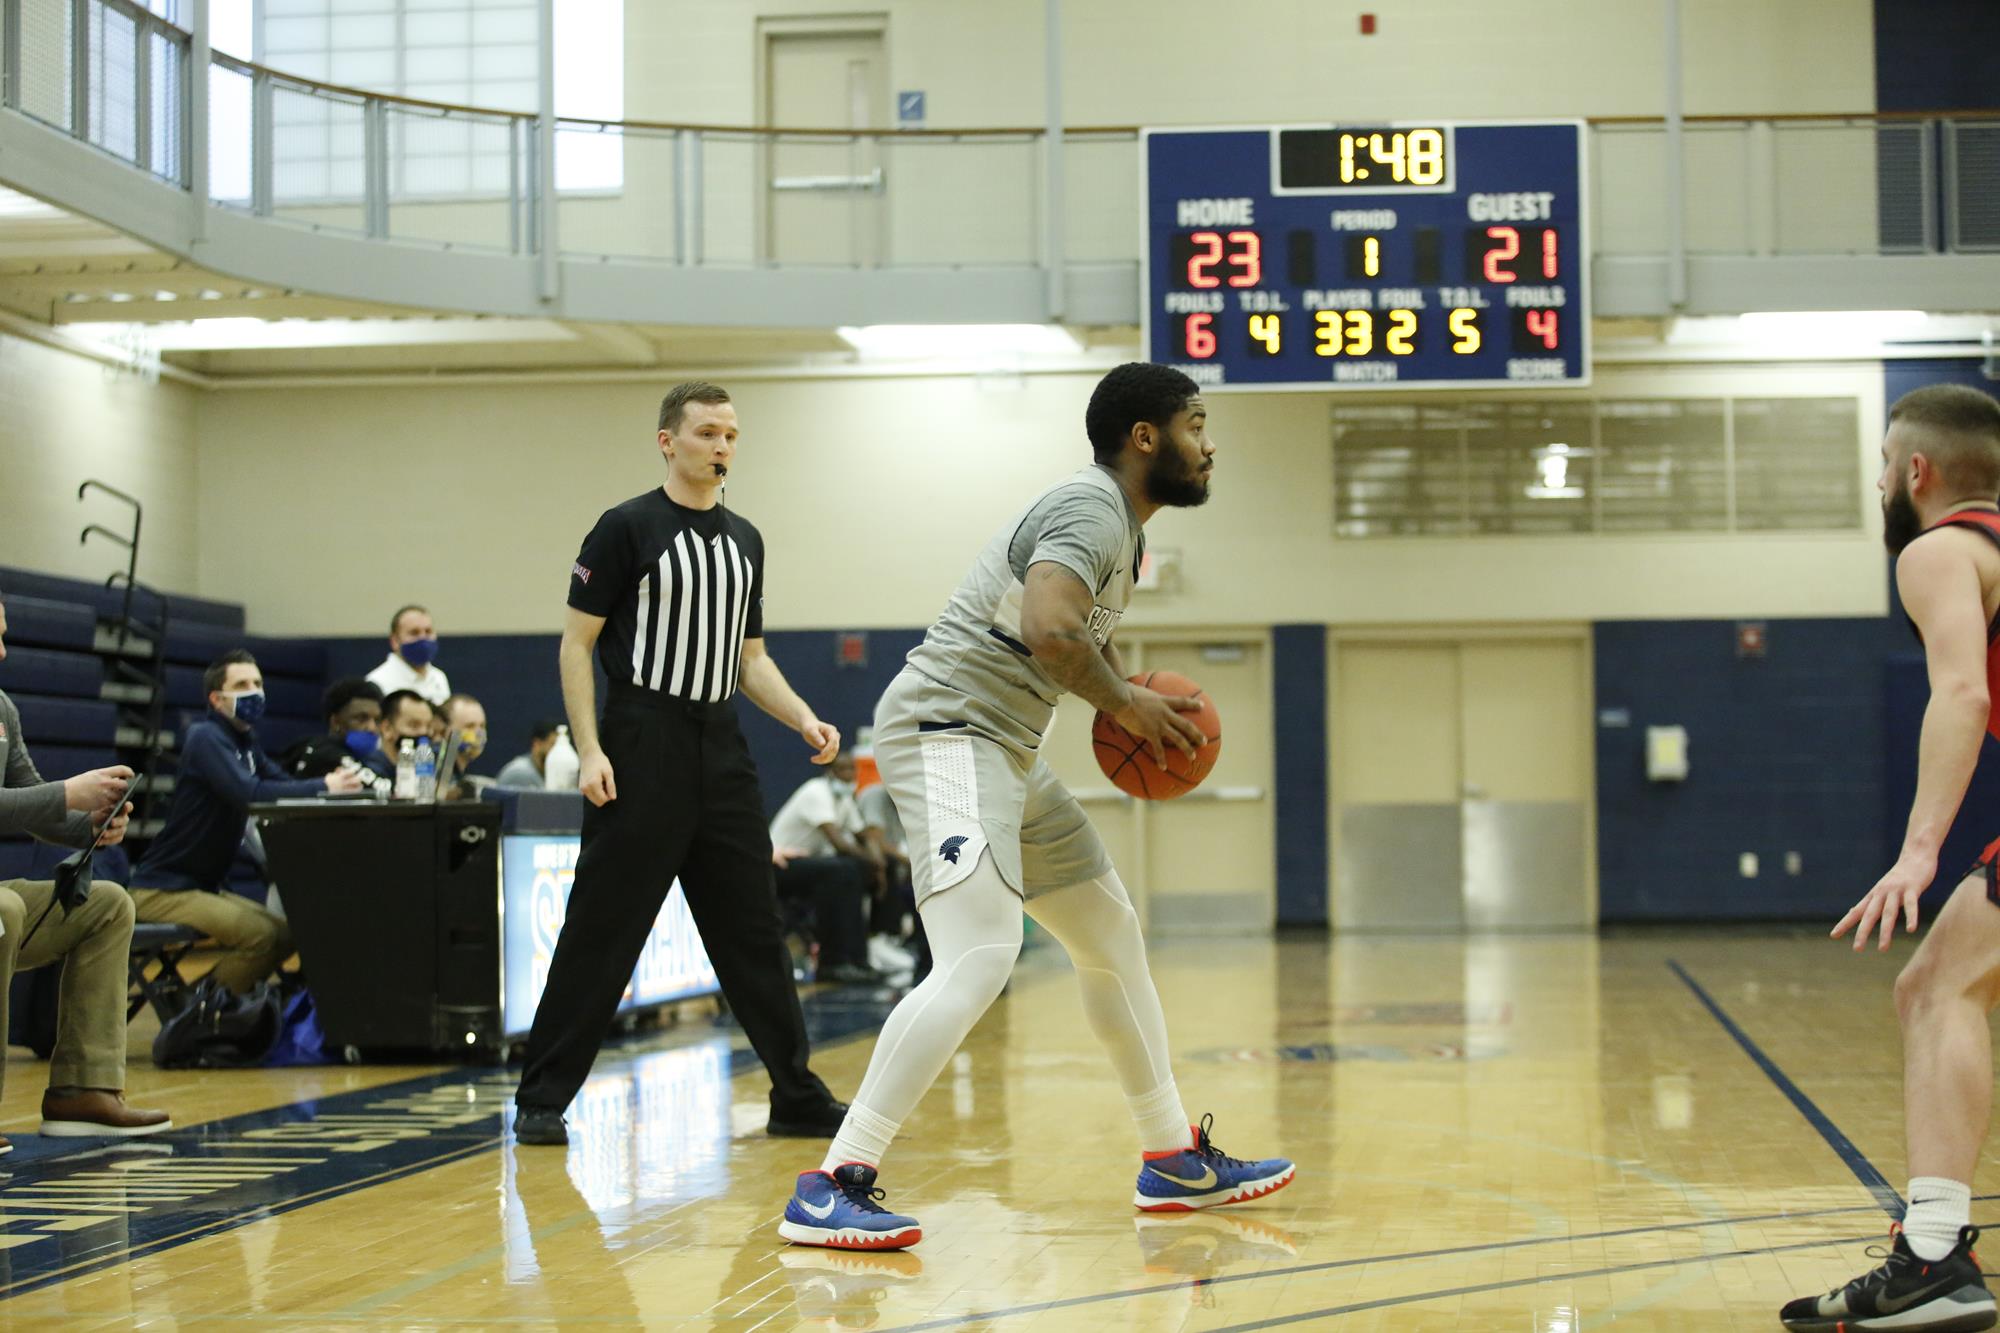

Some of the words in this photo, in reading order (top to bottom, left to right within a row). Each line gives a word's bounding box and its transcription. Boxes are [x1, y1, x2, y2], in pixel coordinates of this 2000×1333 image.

[1340, 129, 1443, 185] 1:48
[1177, 199, 1254, 226] HOME
[1331, 209, 1397, 230] PERIOD
[1468, 192, 1554, 221] GUEST
[1187, 231, 1261, 288] 23
[1364, 237, 1379, 277] 1
[1483, 226, 1558, 283] 21
[1165, 291, 1224, 313] FOULS
[1303, 289, 1372, 310] PLAYER
[1378, 288, 1427, 309] FOUL
[1506, 285, 1566, 307] FOULS
[1186, 312, 1216, 358] 6
[1249, 314, 1280, 354] 4
[1315, 310, 1373, 356] 33
[1386, 308, 1418, 355] 2
[1449, 307, 1480, 354] 5
[1526, 310, 1558, 349] 4
[1333, 361, 1397, 382] MATCH
